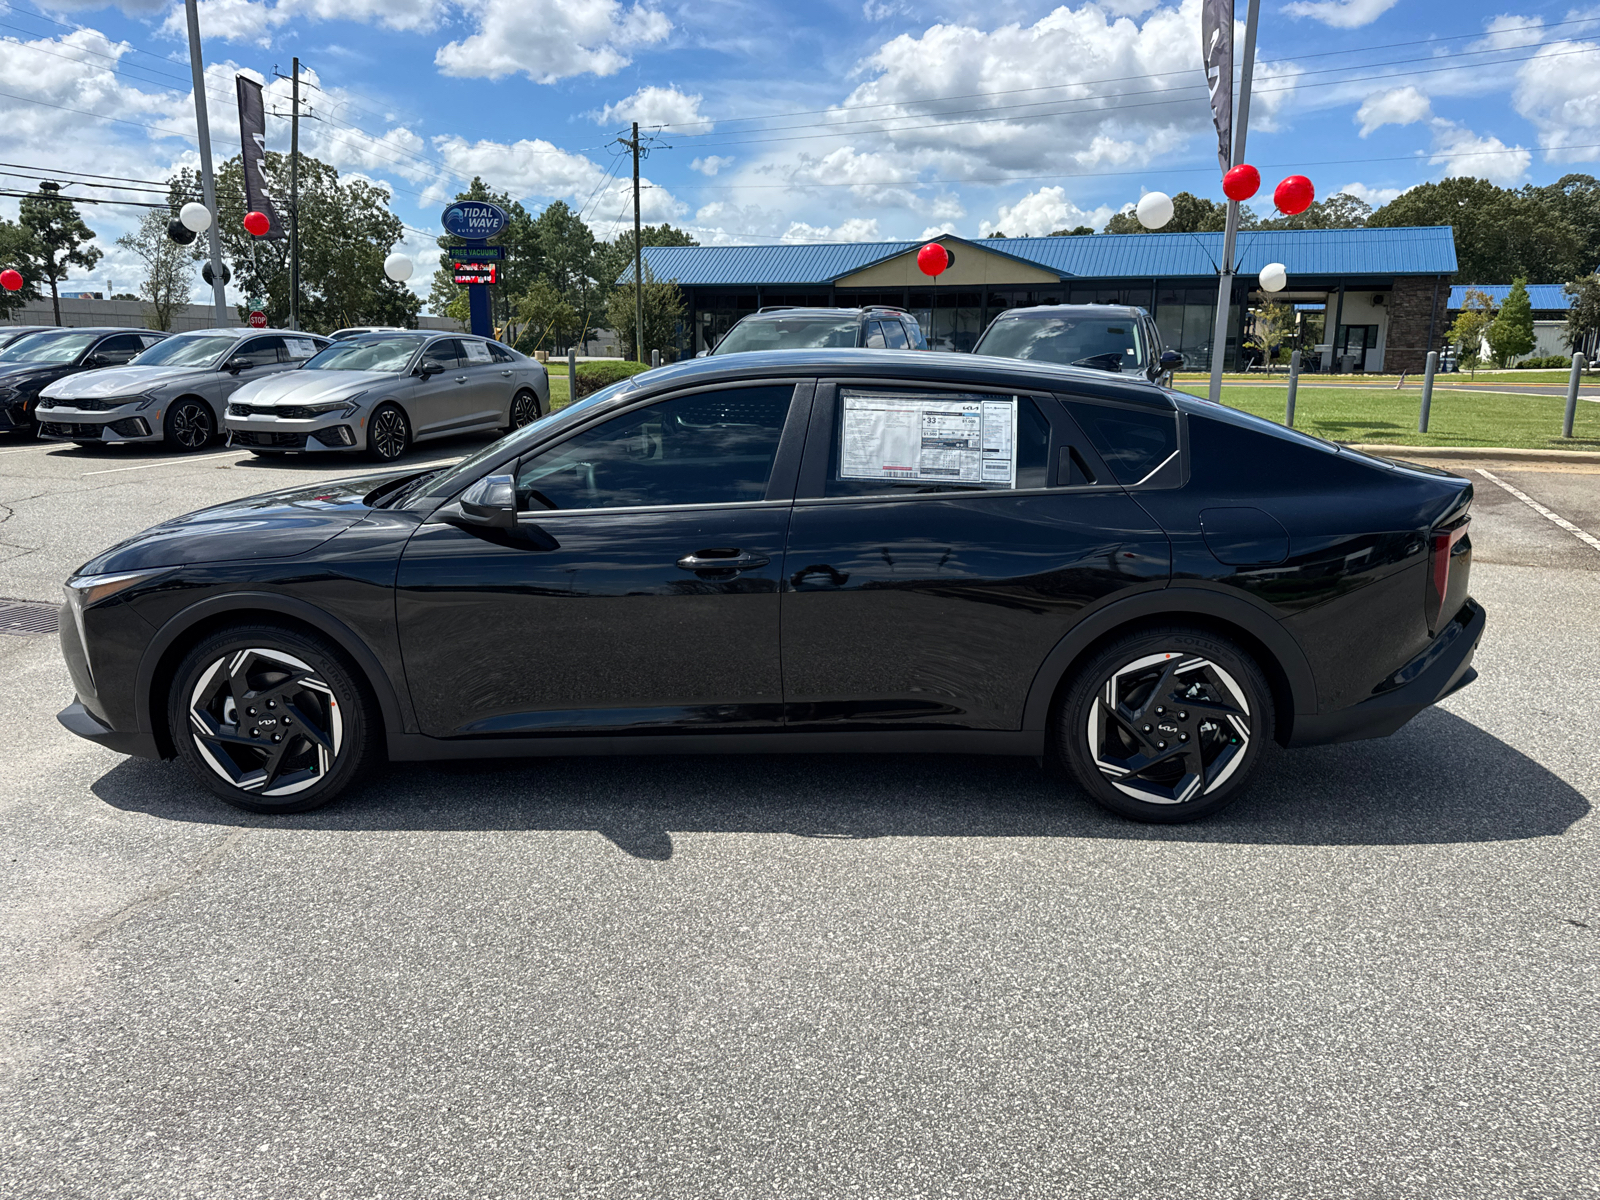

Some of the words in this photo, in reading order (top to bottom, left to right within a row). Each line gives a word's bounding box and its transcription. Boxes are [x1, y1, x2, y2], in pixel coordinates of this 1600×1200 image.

[464, 208, 492, 218] TIDAL
[469, 218, 499, 228] WAVE
[1174, 636, 1221, 654] SOLUS
[319, 658, 351, 701] KUMHO
[1158, 724, 1178, 732] KIA
